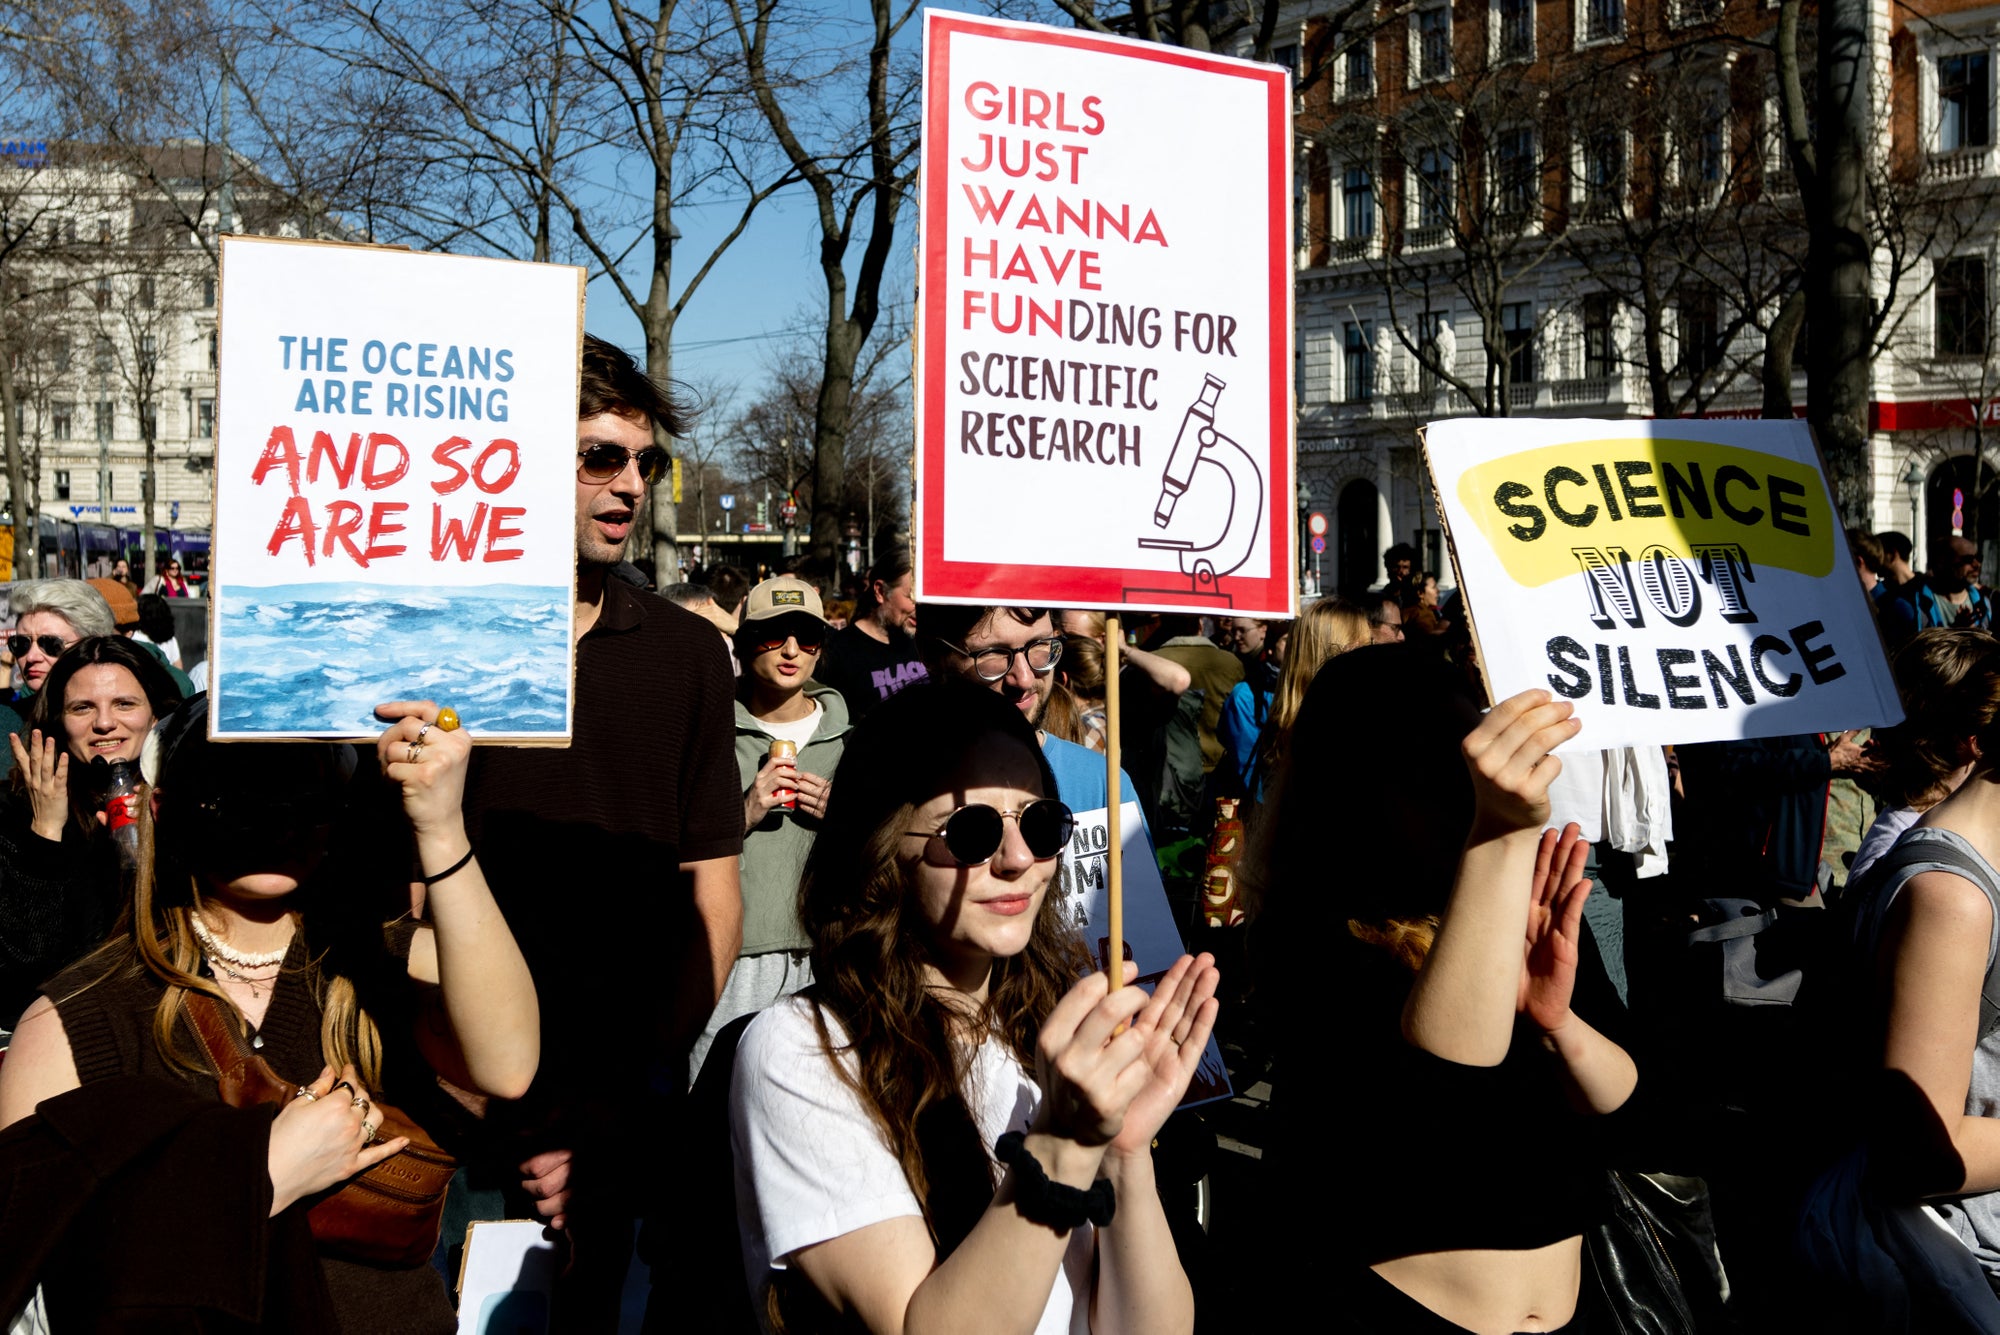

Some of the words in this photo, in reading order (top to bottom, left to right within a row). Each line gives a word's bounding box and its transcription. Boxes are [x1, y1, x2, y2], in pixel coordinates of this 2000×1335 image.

[964, 81, 1105, 135] GIRLS
[0, 141, 48, 155] ANK
[960, 133, 1089, 184] JUST
[961, 183, 1169, 248] WANNA
[964, 237, 1102, 291] HAVE
[963, 289, 1162, 349] FUNDING
[1174, 310, 1237, 357] FOR
[279, 336, 347, 372] THE
[363, 340, 515, 383] OCEANS
[960, 351, 1158, 411] SCIENTIFIC
[295, 379, 372, 414] ARE
[387, 383, 508, 422] RISING
[252, 425, 410, 495] AND
[430, 435, 521, 496] SO
[961, 410, 1140, 467] RESEARCH
[1298, 438, 1356, 452] Donald's
[721, 497, 733, 509] U
[1494, 461, 1810, 542] SCIENCE
[267, 496, 409, 568] ARE
[430, 502, 527, 563] WE
[1571, 543, 1759, 630] NOT
[1546, 620, 1846, 710] SILENCE
